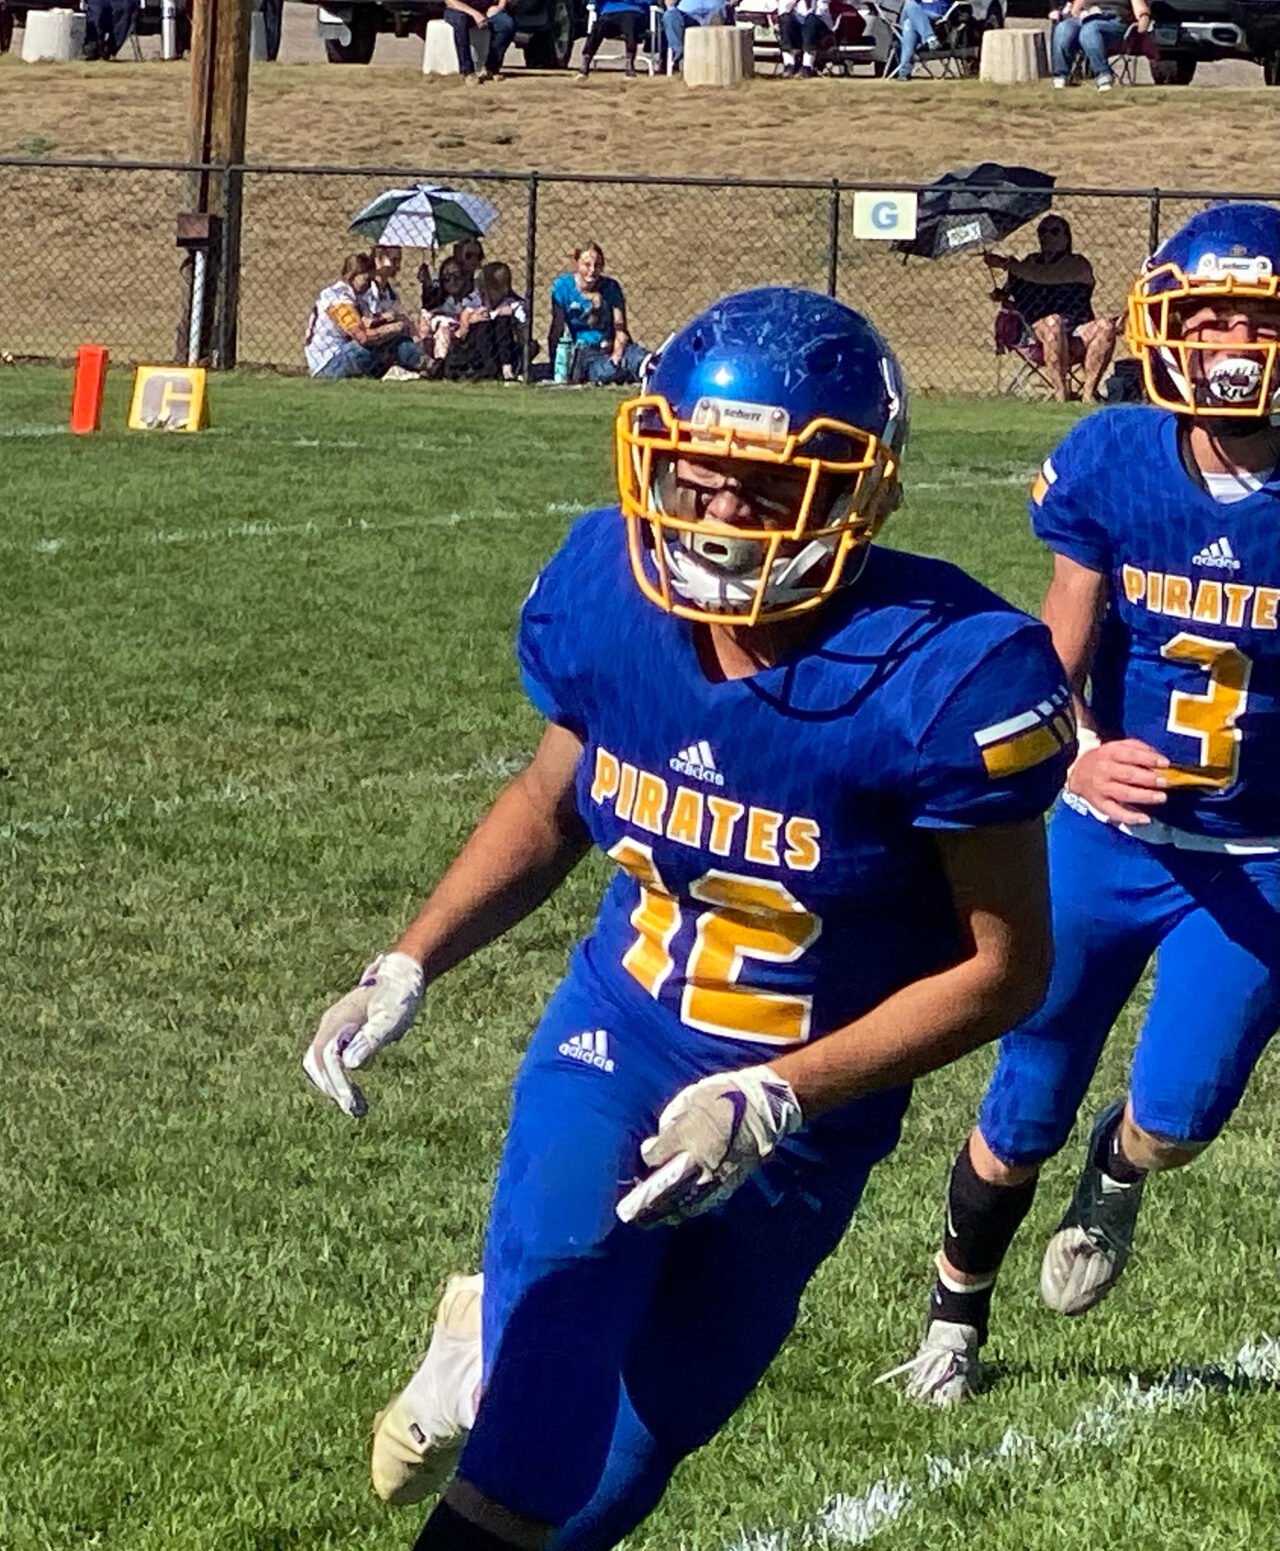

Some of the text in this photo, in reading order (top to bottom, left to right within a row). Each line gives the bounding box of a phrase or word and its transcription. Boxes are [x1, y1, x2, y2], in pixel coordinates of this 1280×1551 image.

[871, 201, 898, 230] G
[140, 375, 192, 427] G
[1123, 563, 1280, 630] PIRATE
[1154, 632, 1253, 795] 3
[669, 756, 724, 786] adidas
[591, 747, 821, 871] PIRATES
[607, 836, 823, 1046] 12
[558, 1042, 615, 1073] adidas
